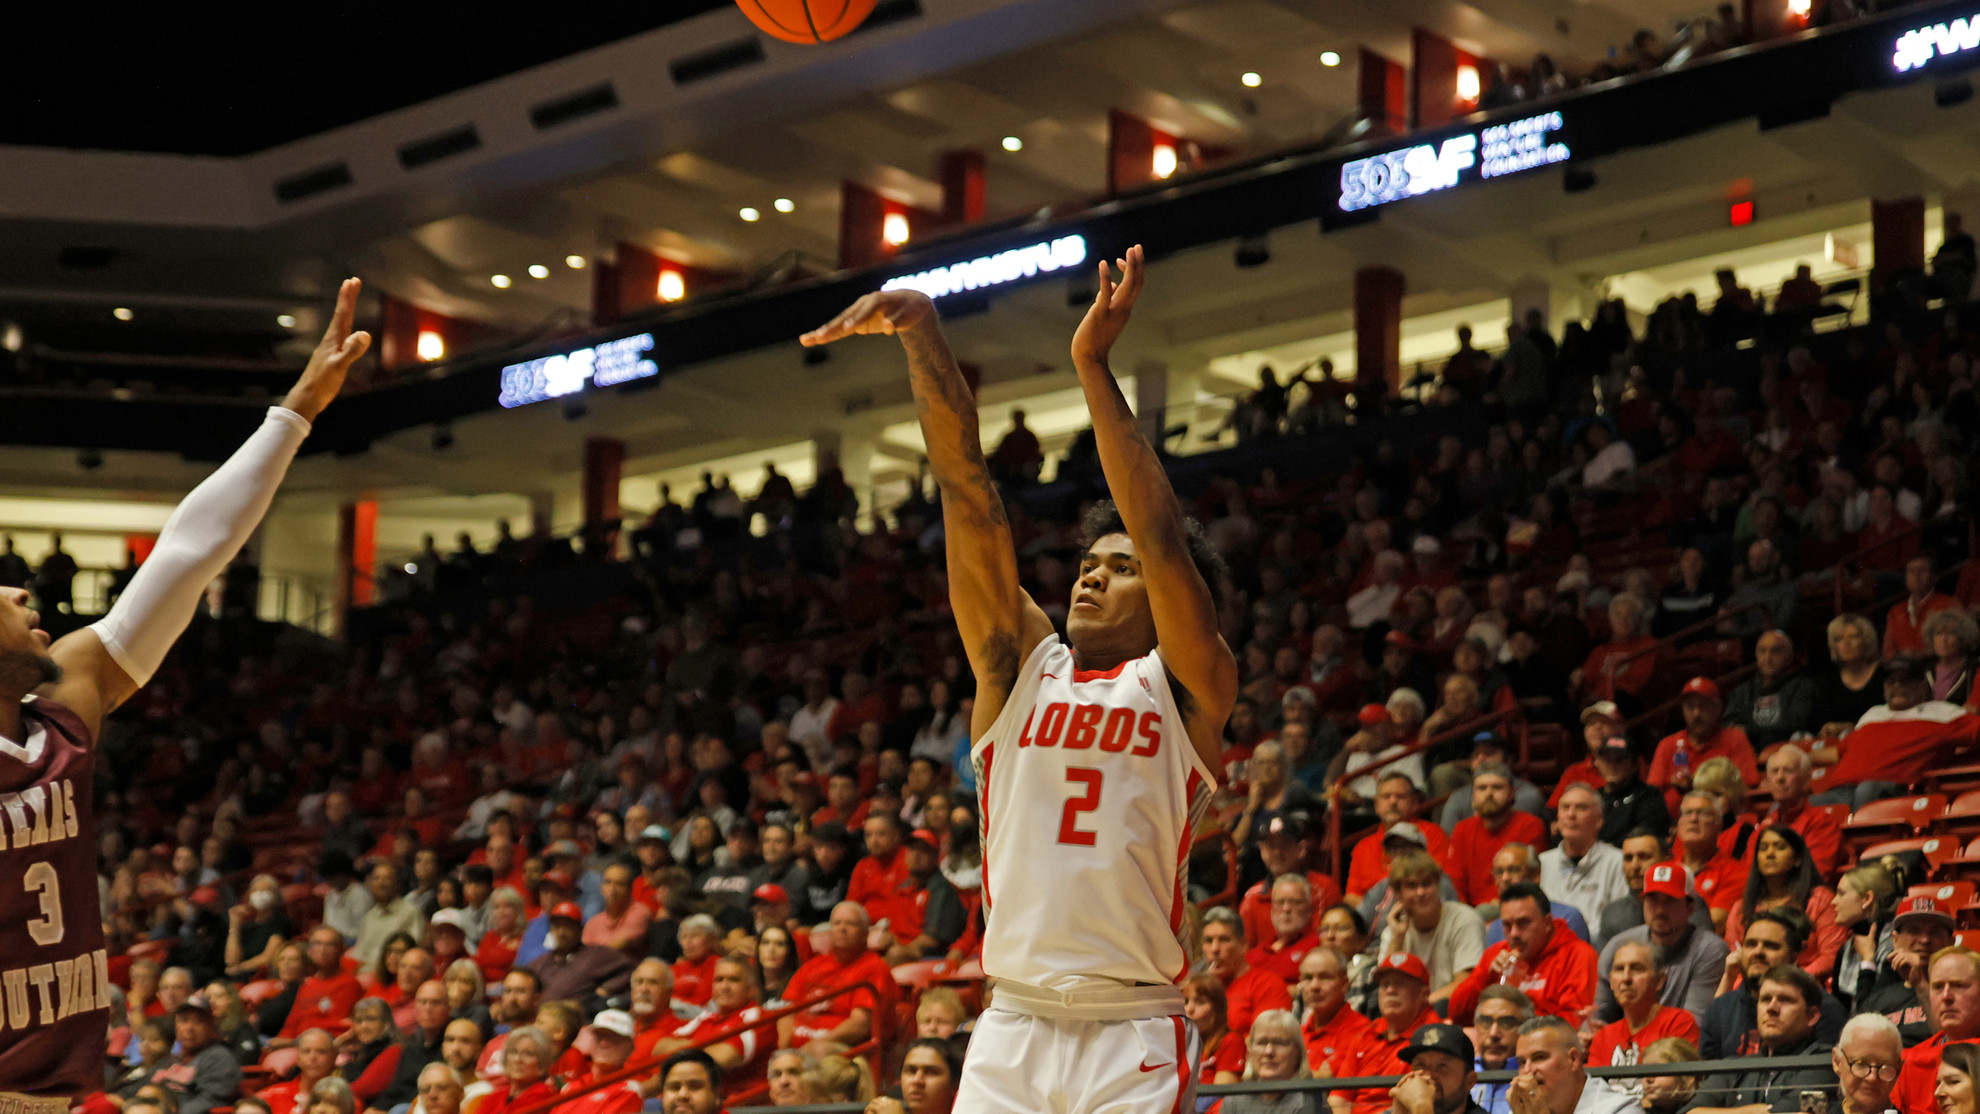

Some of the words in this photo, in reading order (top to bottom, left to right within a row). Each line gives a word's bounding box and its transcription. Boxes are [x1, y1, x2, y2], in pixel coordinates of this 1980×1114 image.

[1018, 702, 1162, 758] LOBOS
[1055, 765, 1104, 848] 2
[24, 861, 65, 946] 3
